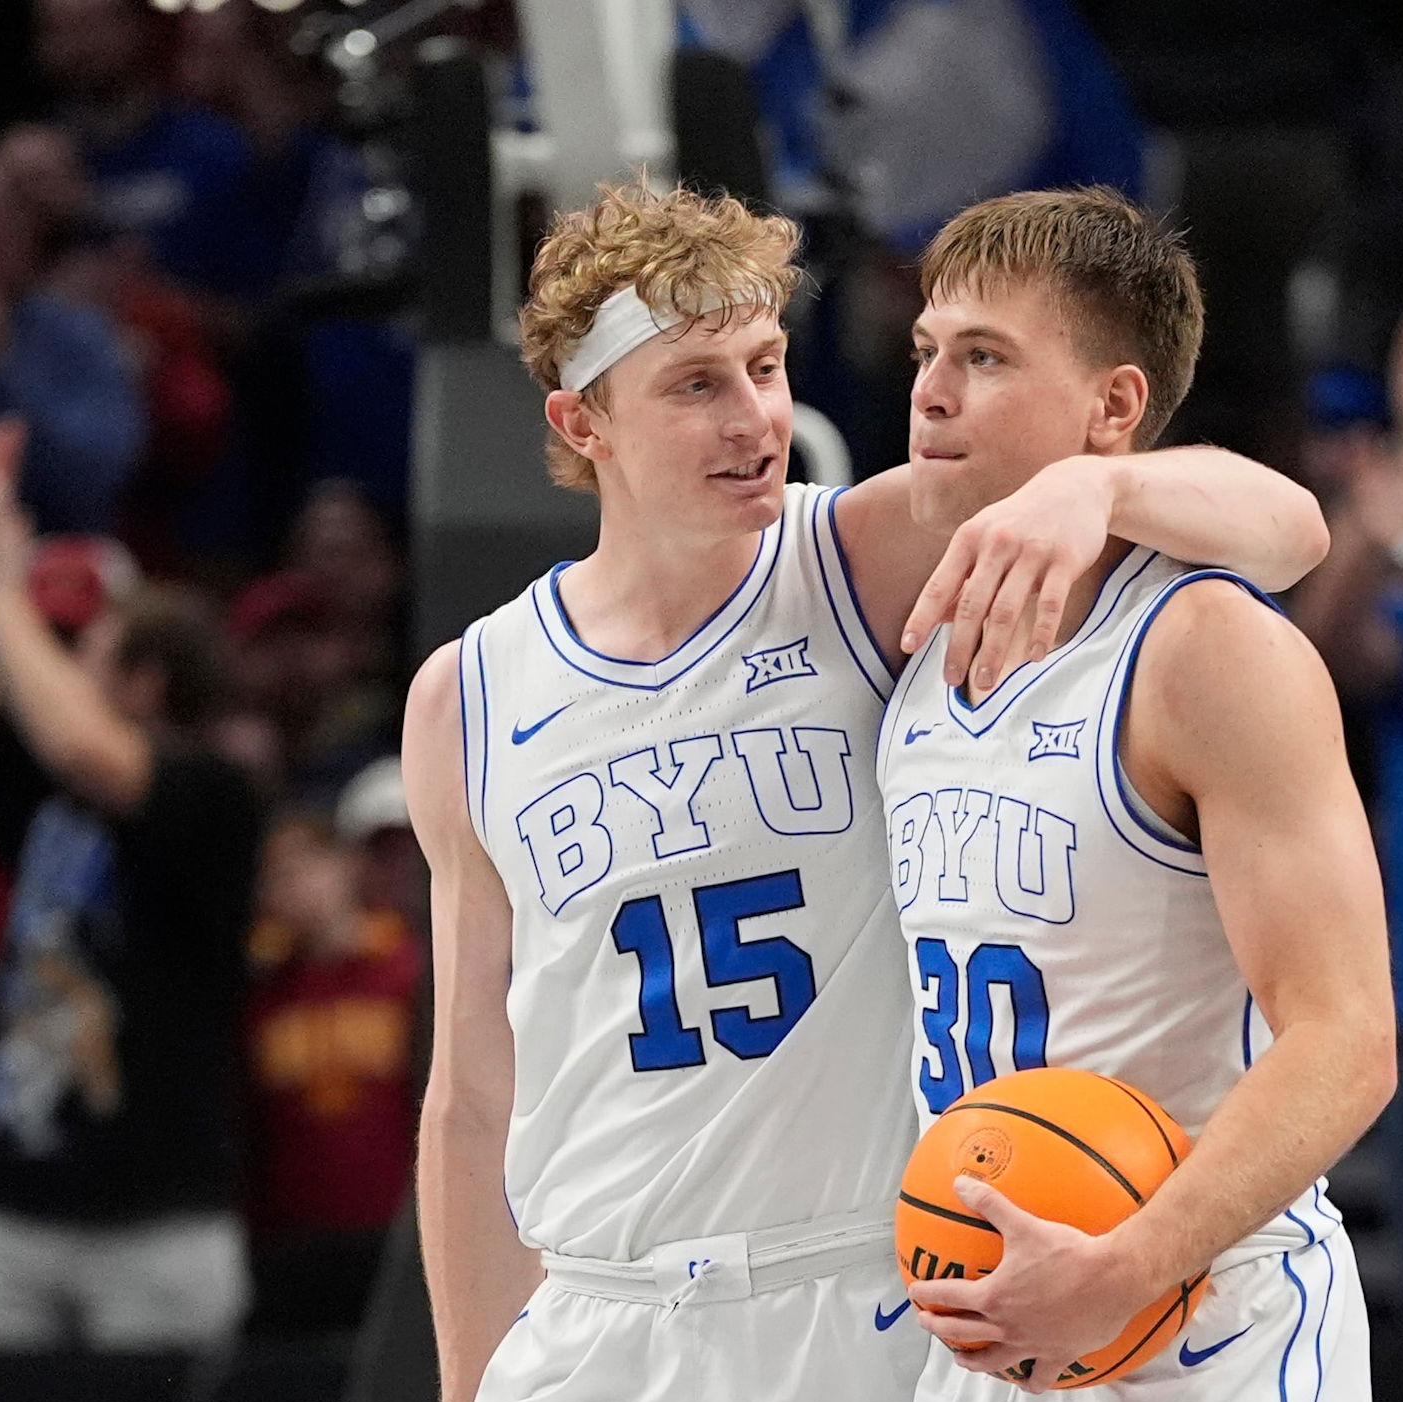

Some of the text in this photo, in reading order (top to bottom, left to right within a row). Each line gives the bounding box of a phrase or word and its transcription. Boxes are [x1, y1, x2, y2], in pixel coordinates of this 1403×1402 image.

[516, 727, 853, 917] BYU
[890, 788, 1077, 925] BYU
[610, 868, 817, 1072] 15
[915, 936, 1050, 1115] 30
